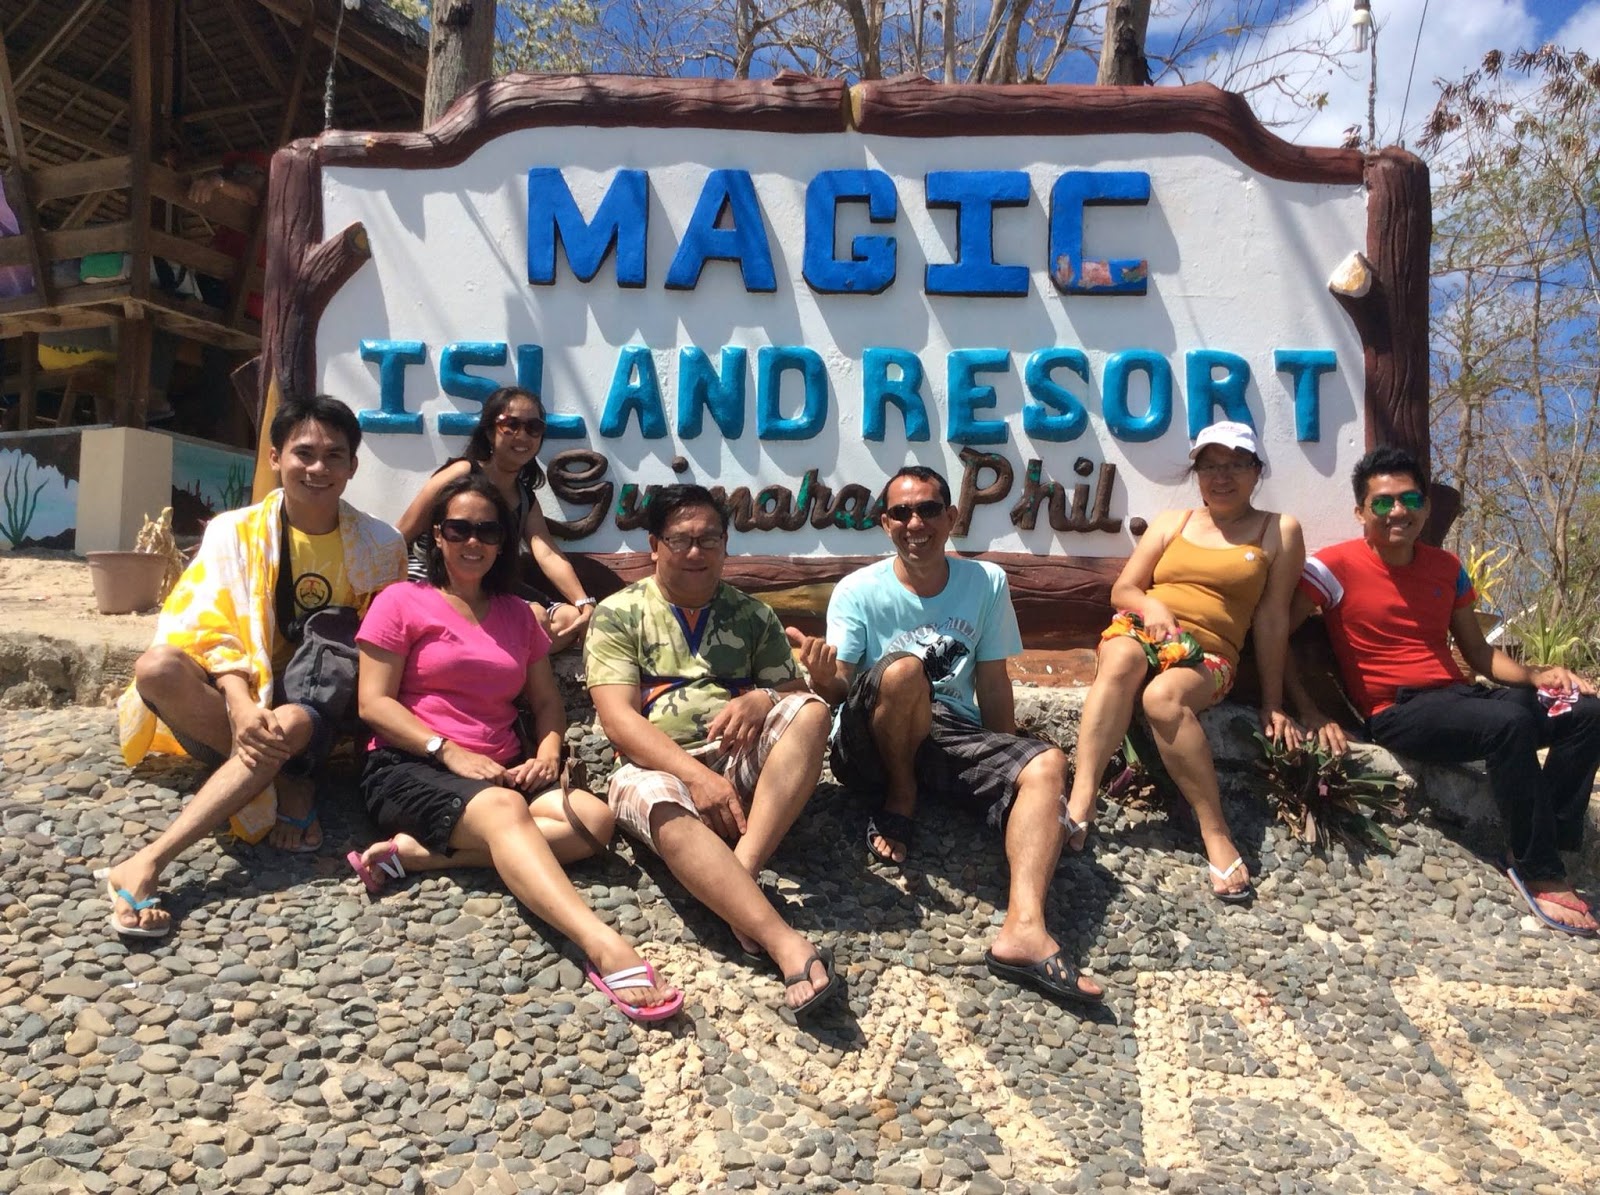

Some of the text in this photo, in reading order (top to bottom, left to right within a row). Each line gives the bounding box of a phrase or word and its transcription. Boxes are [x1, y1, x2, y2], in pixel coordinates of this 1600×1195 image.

[528, 167, 1150, 296] MAGIC
[359, 339, 1336, 445] ISLAND RESORT
[950, 446, 1148, 538] Phil.
